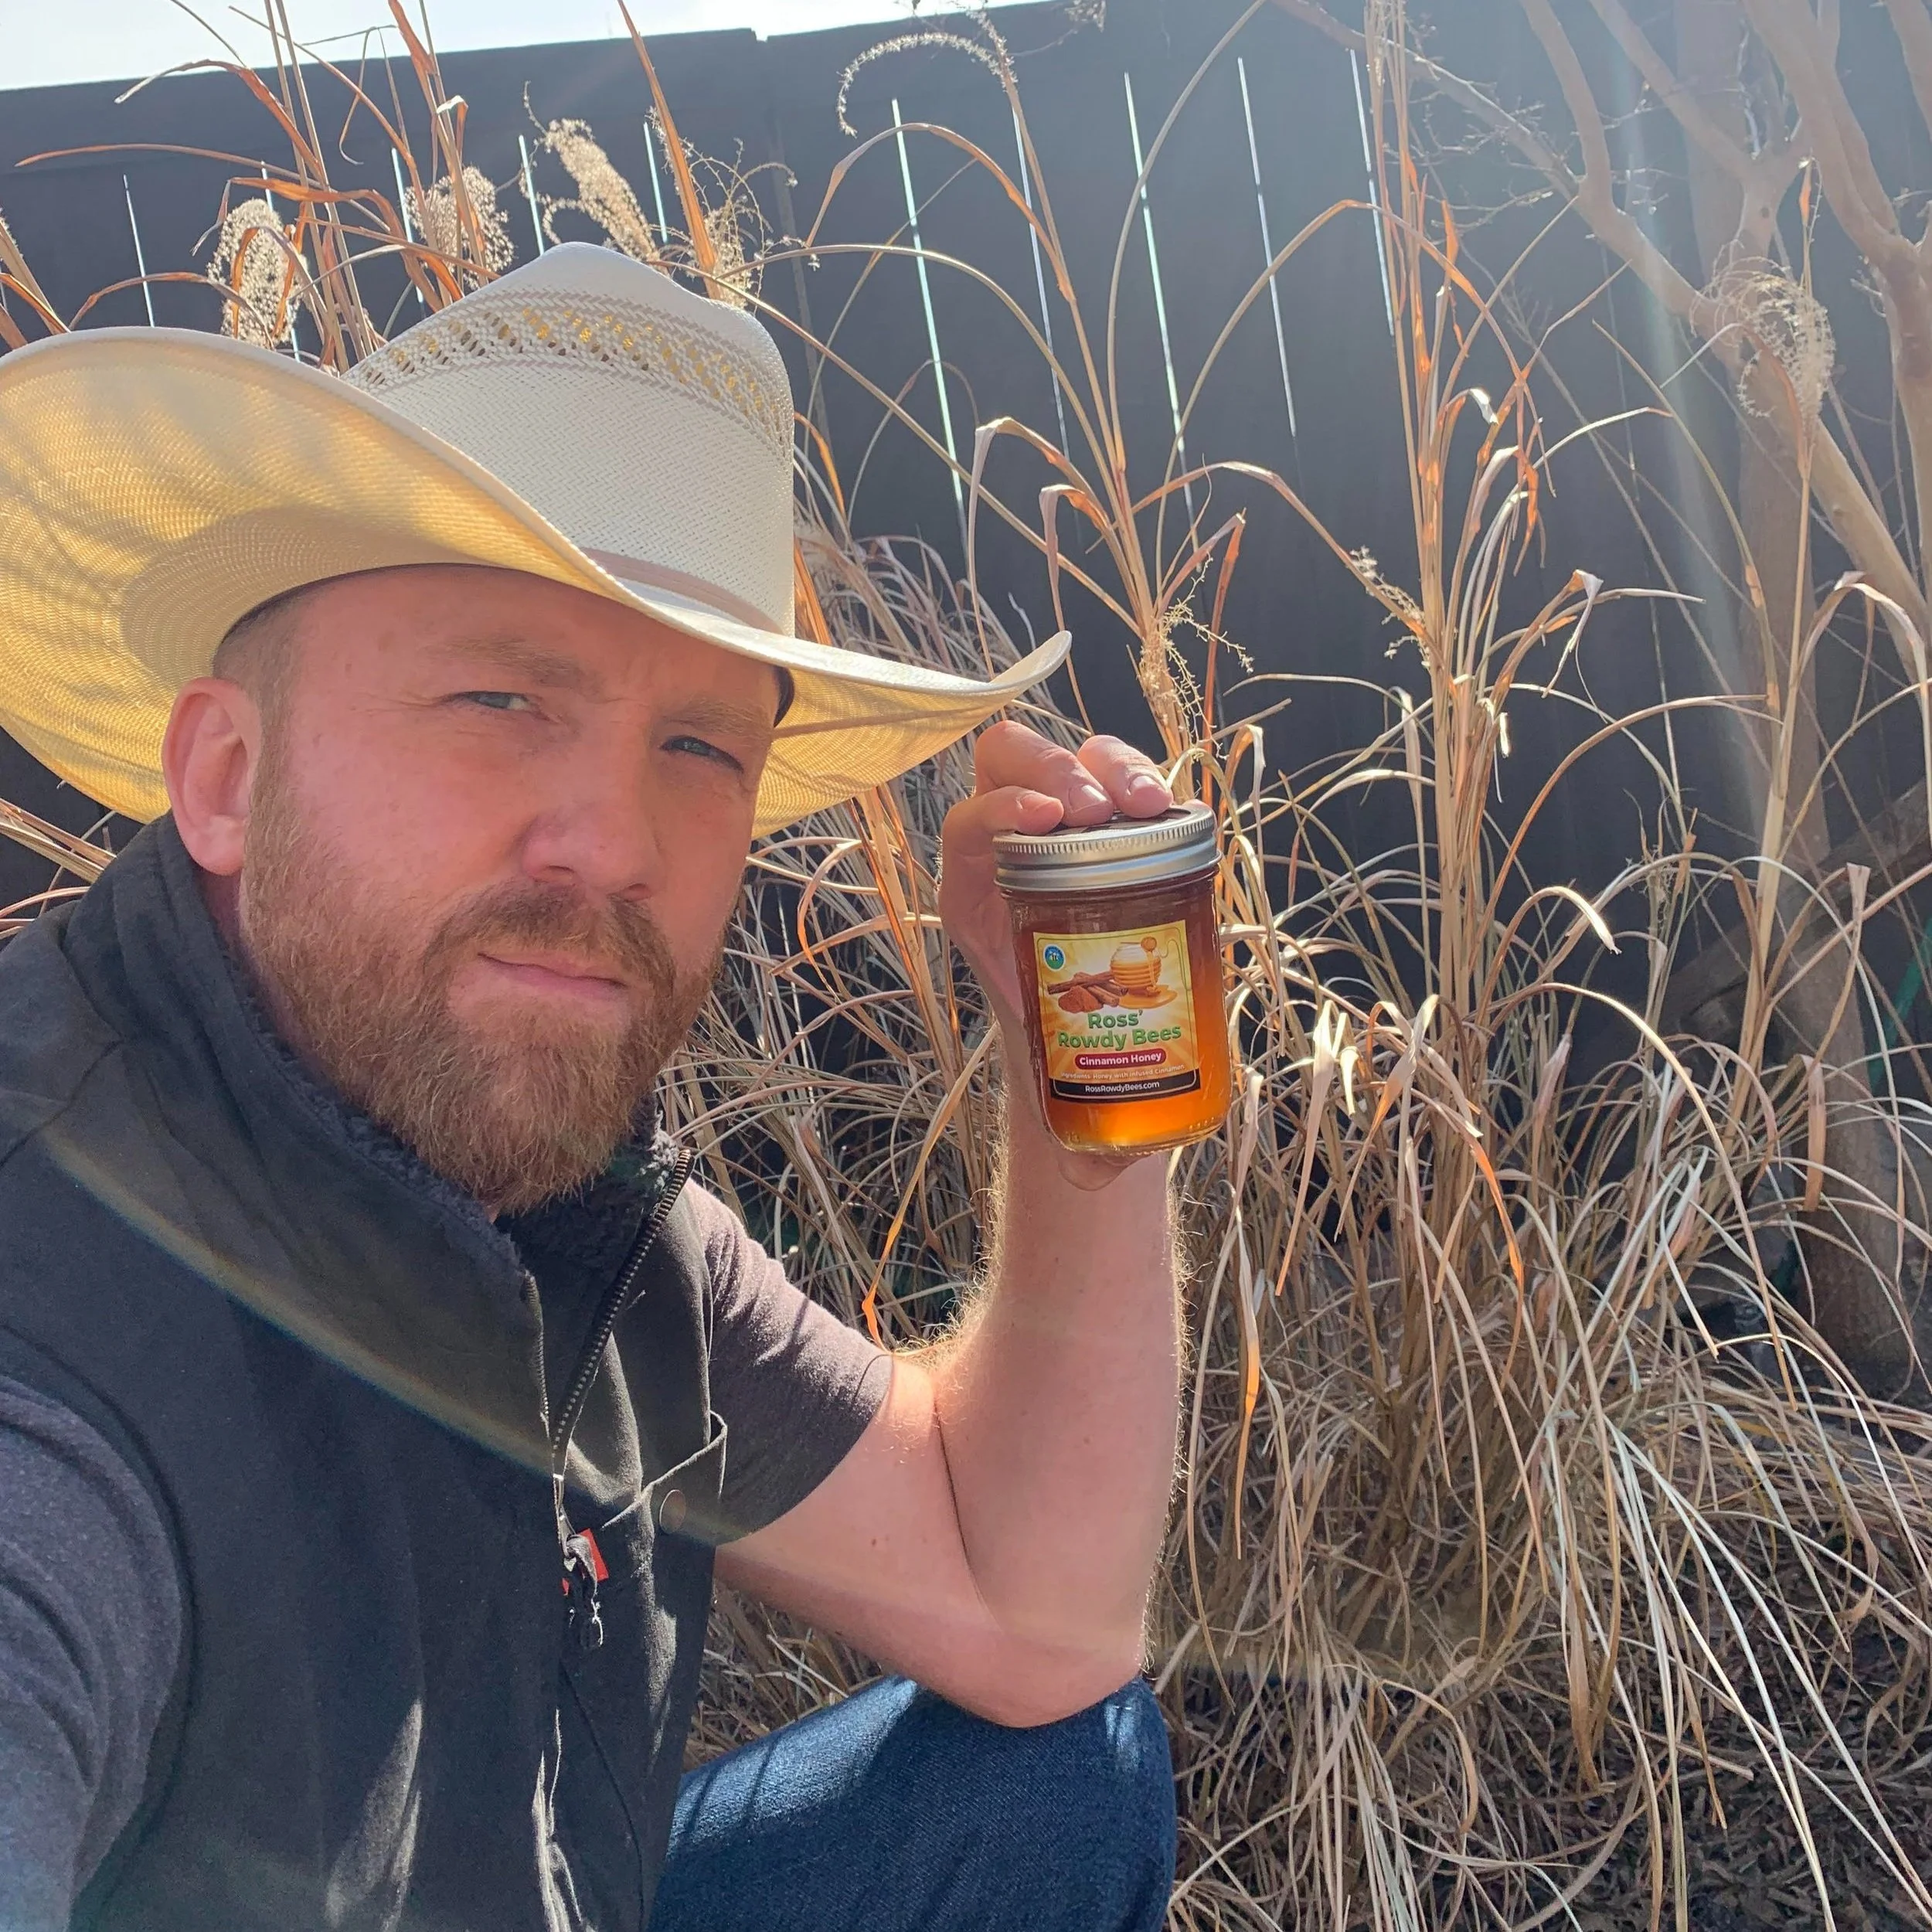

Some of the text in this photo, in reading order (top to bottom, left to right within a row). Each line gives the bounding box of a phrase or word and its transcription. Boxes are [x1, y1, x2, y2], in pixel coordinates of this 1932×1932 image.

[1057, 1025, 1182, 1051] Rowdy Bees
[1079, 1052, 1162, 1066] Cinnamon Honey
[1085, 1080, 1160, 1093] RossRowdyBees.com
